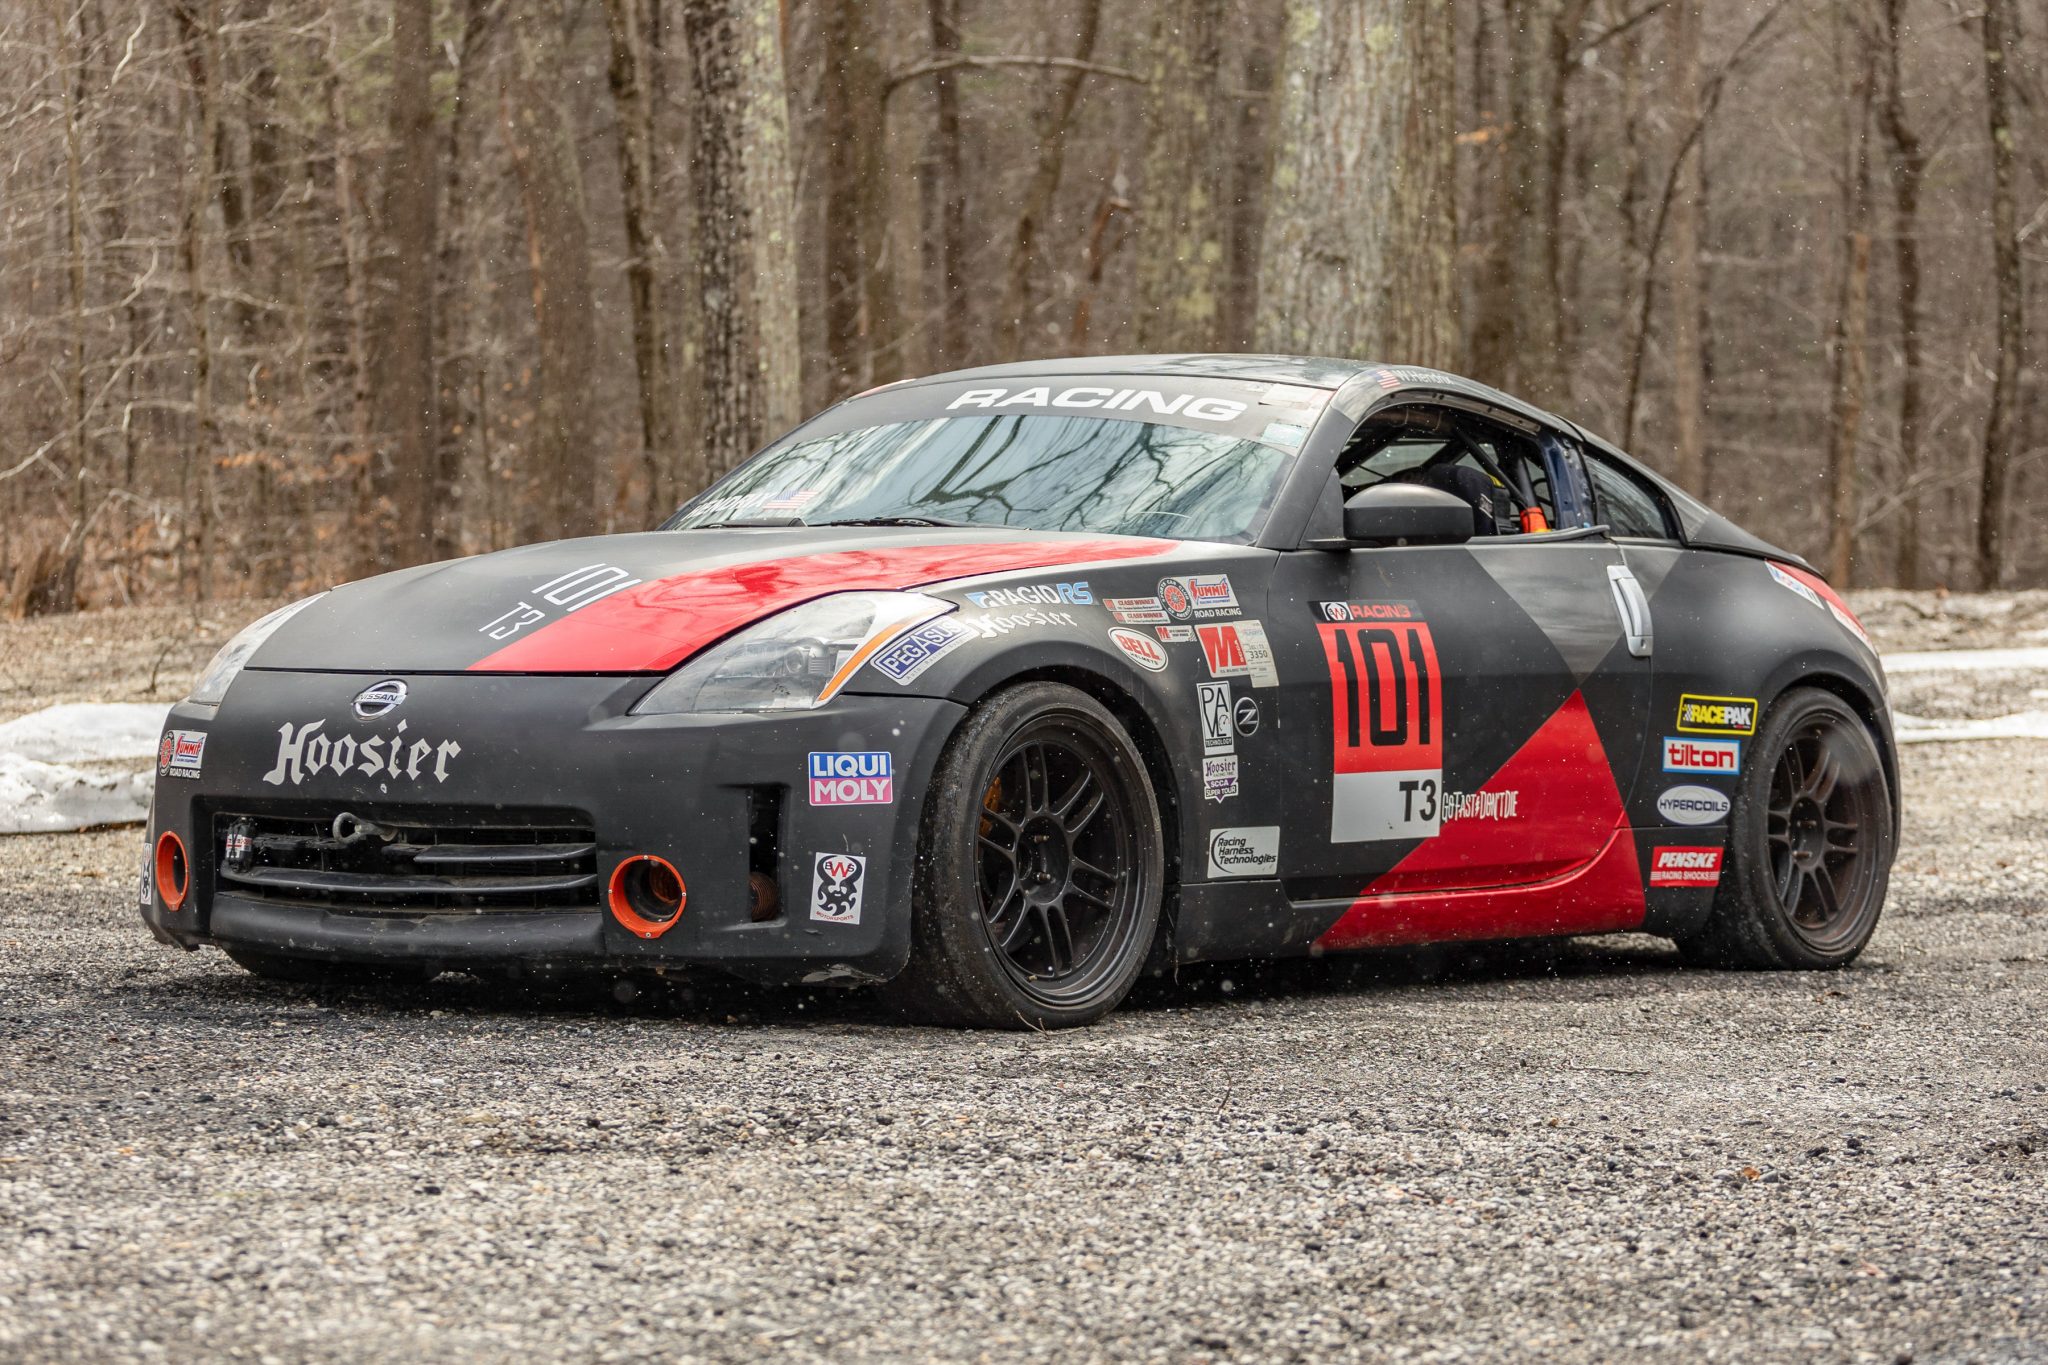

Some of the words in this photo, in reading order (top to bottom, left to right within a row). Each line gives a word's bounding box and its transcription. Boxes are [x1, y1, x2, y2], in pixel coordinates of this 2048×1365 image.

[944, 387, 1248, 422] RACING
[530, 563, 643, 613] 101
[989, 584, 1061, 608] PAGID
[1055, 581, 1095, 606] RS
[1194, 609, 1215, 619] ROAD
[1214, 607, 1243, 617] RACING
[1349, 603, 1412, 619] RACING
[478, 601, 546, 641] T3
[966, 607, 1079, 639] Hoosier
[883, 621, 963, 674] PEGASUS
[1115, 634, 1162, 661] BELL
[1249, 649, 1268, 659] 3350
[1334, 628, 1432, 748] 101
[360, 693, 398, 702] NISSAN
[1691, 704, 1752, 726] RACEPAK
[1205, 737, 1233, 748] TECHNOLOGY
[261, 717, 462, 787] Hoosier
[1668, 743, 1734, 769] tilton
[169, 767, 183, 778] ROAD
[181, 768, 201, 779] RACING
[813, 755, 888, 778] LIQUI
[1205, 760, 1236, 778] Hoosier
[814, 779, 890, 802] MOLY
[1206, 788, 1221, 797] SUPER
[1221, 785, 1237, 795] TOUR
[1210, 779, 1229, 788] SCCA
[1399, 779, 1437, 822] T3
[1659, 799, 1728, 812] HYPERCOILS
[1218, 837, 1247, 848] Racing
[1219, 846, 1255, 856] Harness
[1219, 854, 1277, 866] Technologies
[1658, 852, 1718, 869] PENSKE
[1661, 871, 1683, 880] RACING
[815, 910, 854, 922] MOTORSPORTS
